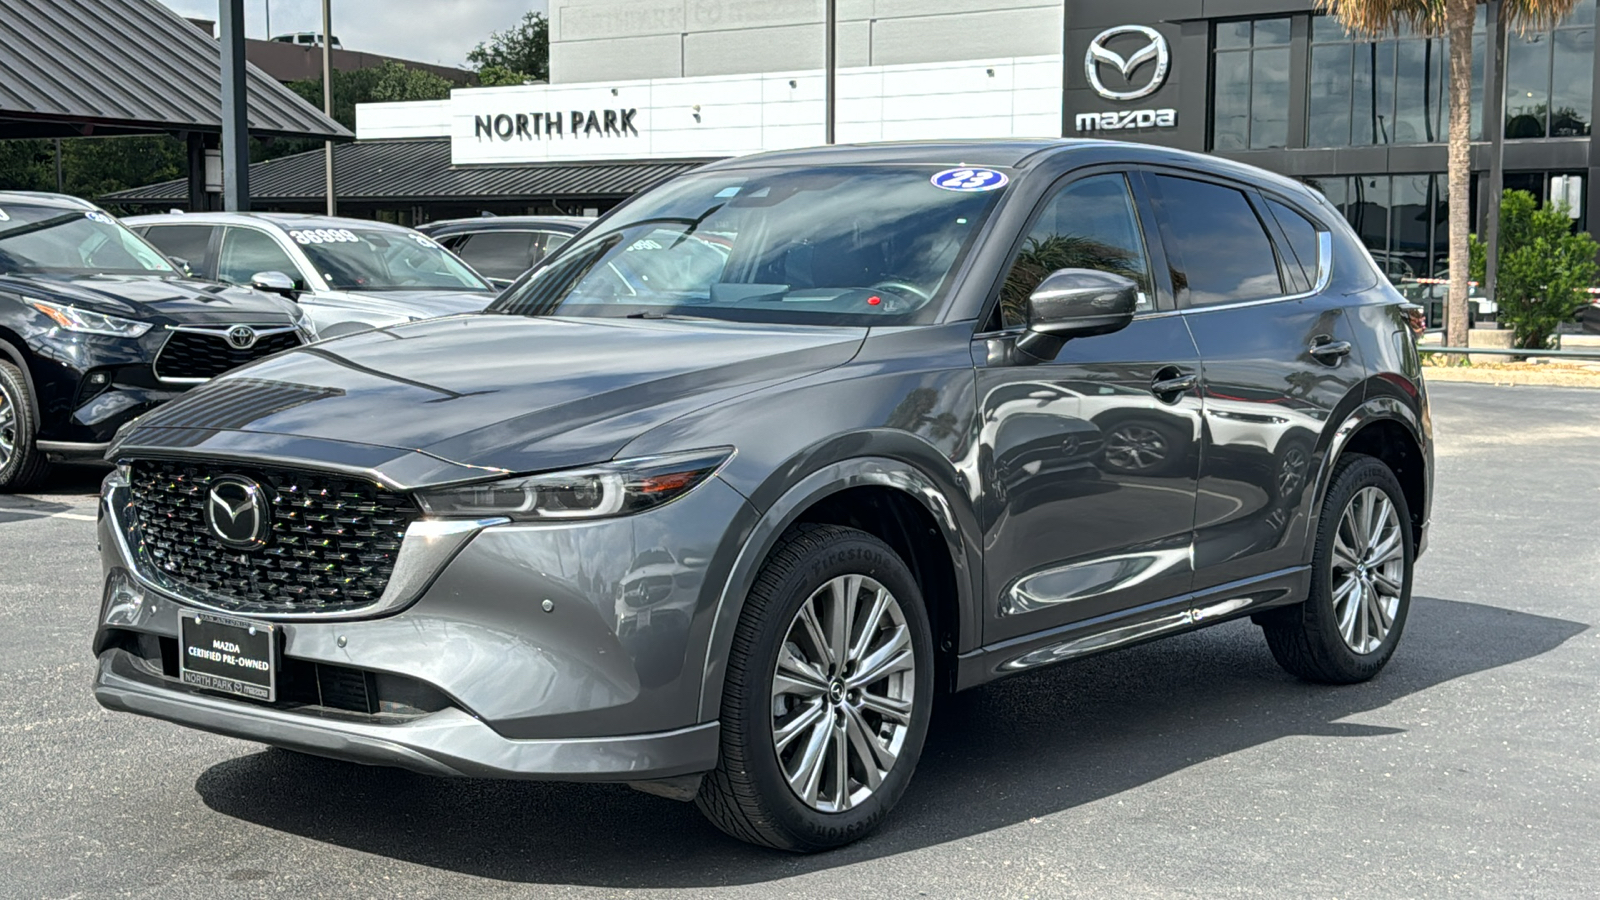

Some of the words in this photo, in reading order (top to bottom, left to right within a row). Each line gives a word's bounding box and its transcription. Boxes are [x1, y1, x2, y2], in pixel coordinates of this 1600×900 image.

[474, 112, 563, 141] NORTH
[570, 108, 638, 137] PARK
[941, 169, 994, 188] 23
[289, 228, 359, 245] 36999
[811, 547, 891, 577] Firestone
[213, 640, 240, 653] MAZDA
[188, 646, 221, 662] CERTIFIED
[222, 653, 269, 671] PRE-OWNED
[185, 672, 211, 687] NORTH
[212, 678, 233, 692] PARK
